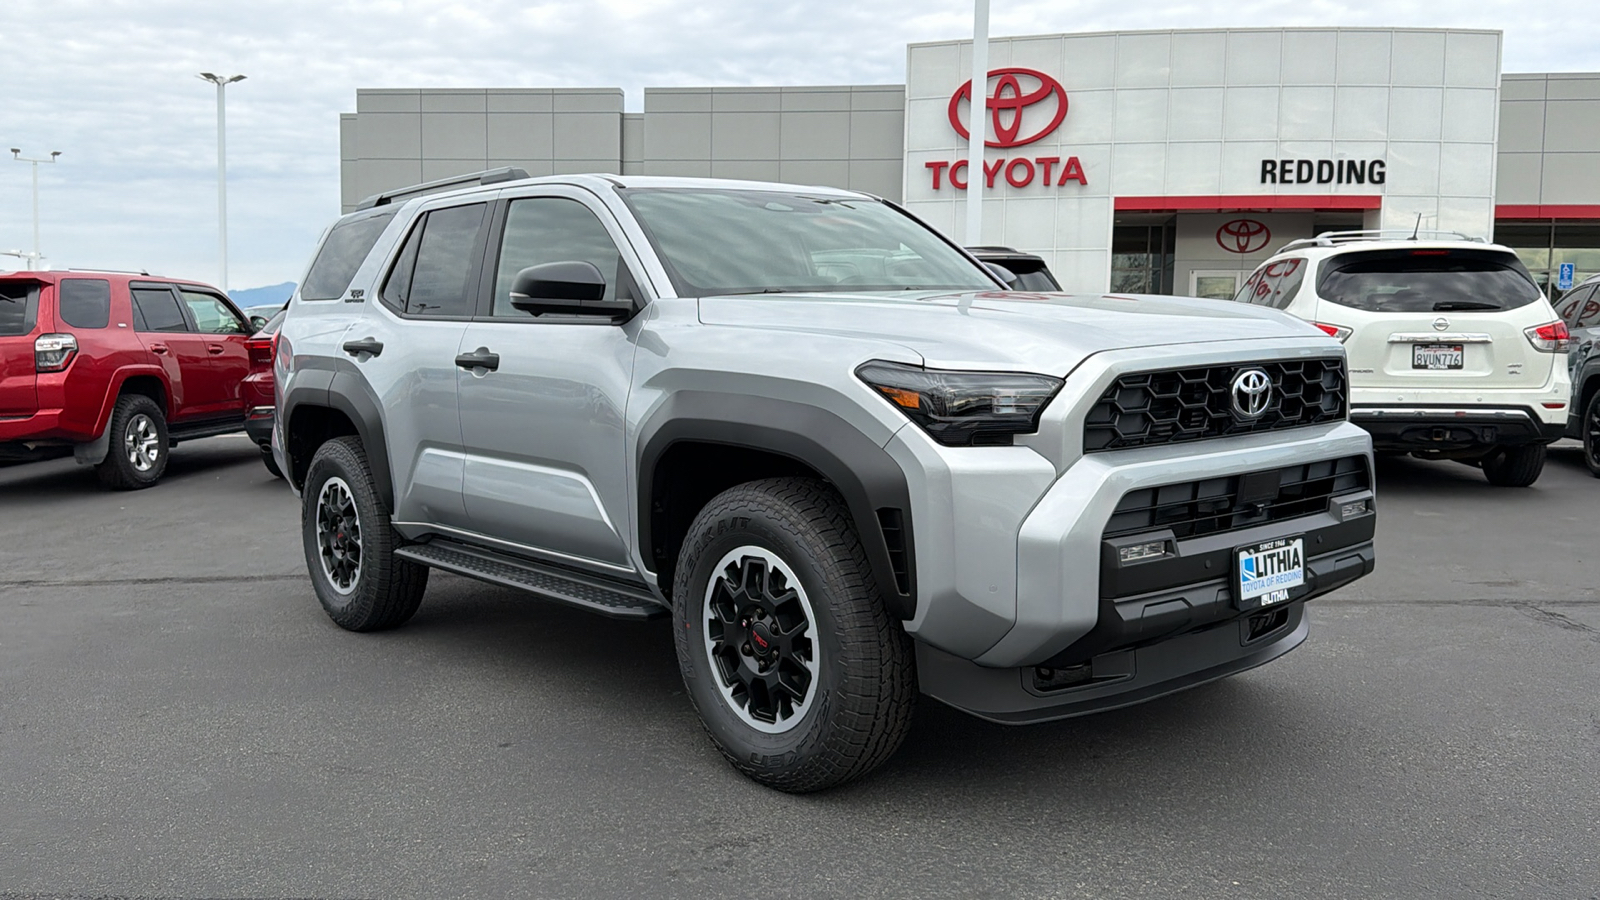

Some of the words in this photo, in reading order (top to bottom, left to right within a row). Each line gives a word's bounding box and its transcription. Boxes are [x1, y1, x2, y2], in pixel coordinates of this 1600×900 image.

[925, 156, 1088, 190] TOYOTA
[1260, 159, 1386, 185] REDDING
[1416, 353, 1460, 366] 8VUN776
[1259, 542, 1274, 551] SINCE
[1255, 547, 1301, 578] LITHIA
[1242, 579, 1266, 592] TOYOTA
[1267, 577, 1275, 587] OF
[1276, 570, 1302, 585] REDDING
[1267, 588, 1289, 604] LITHIA
[752, 630, 768, 649] TRD
